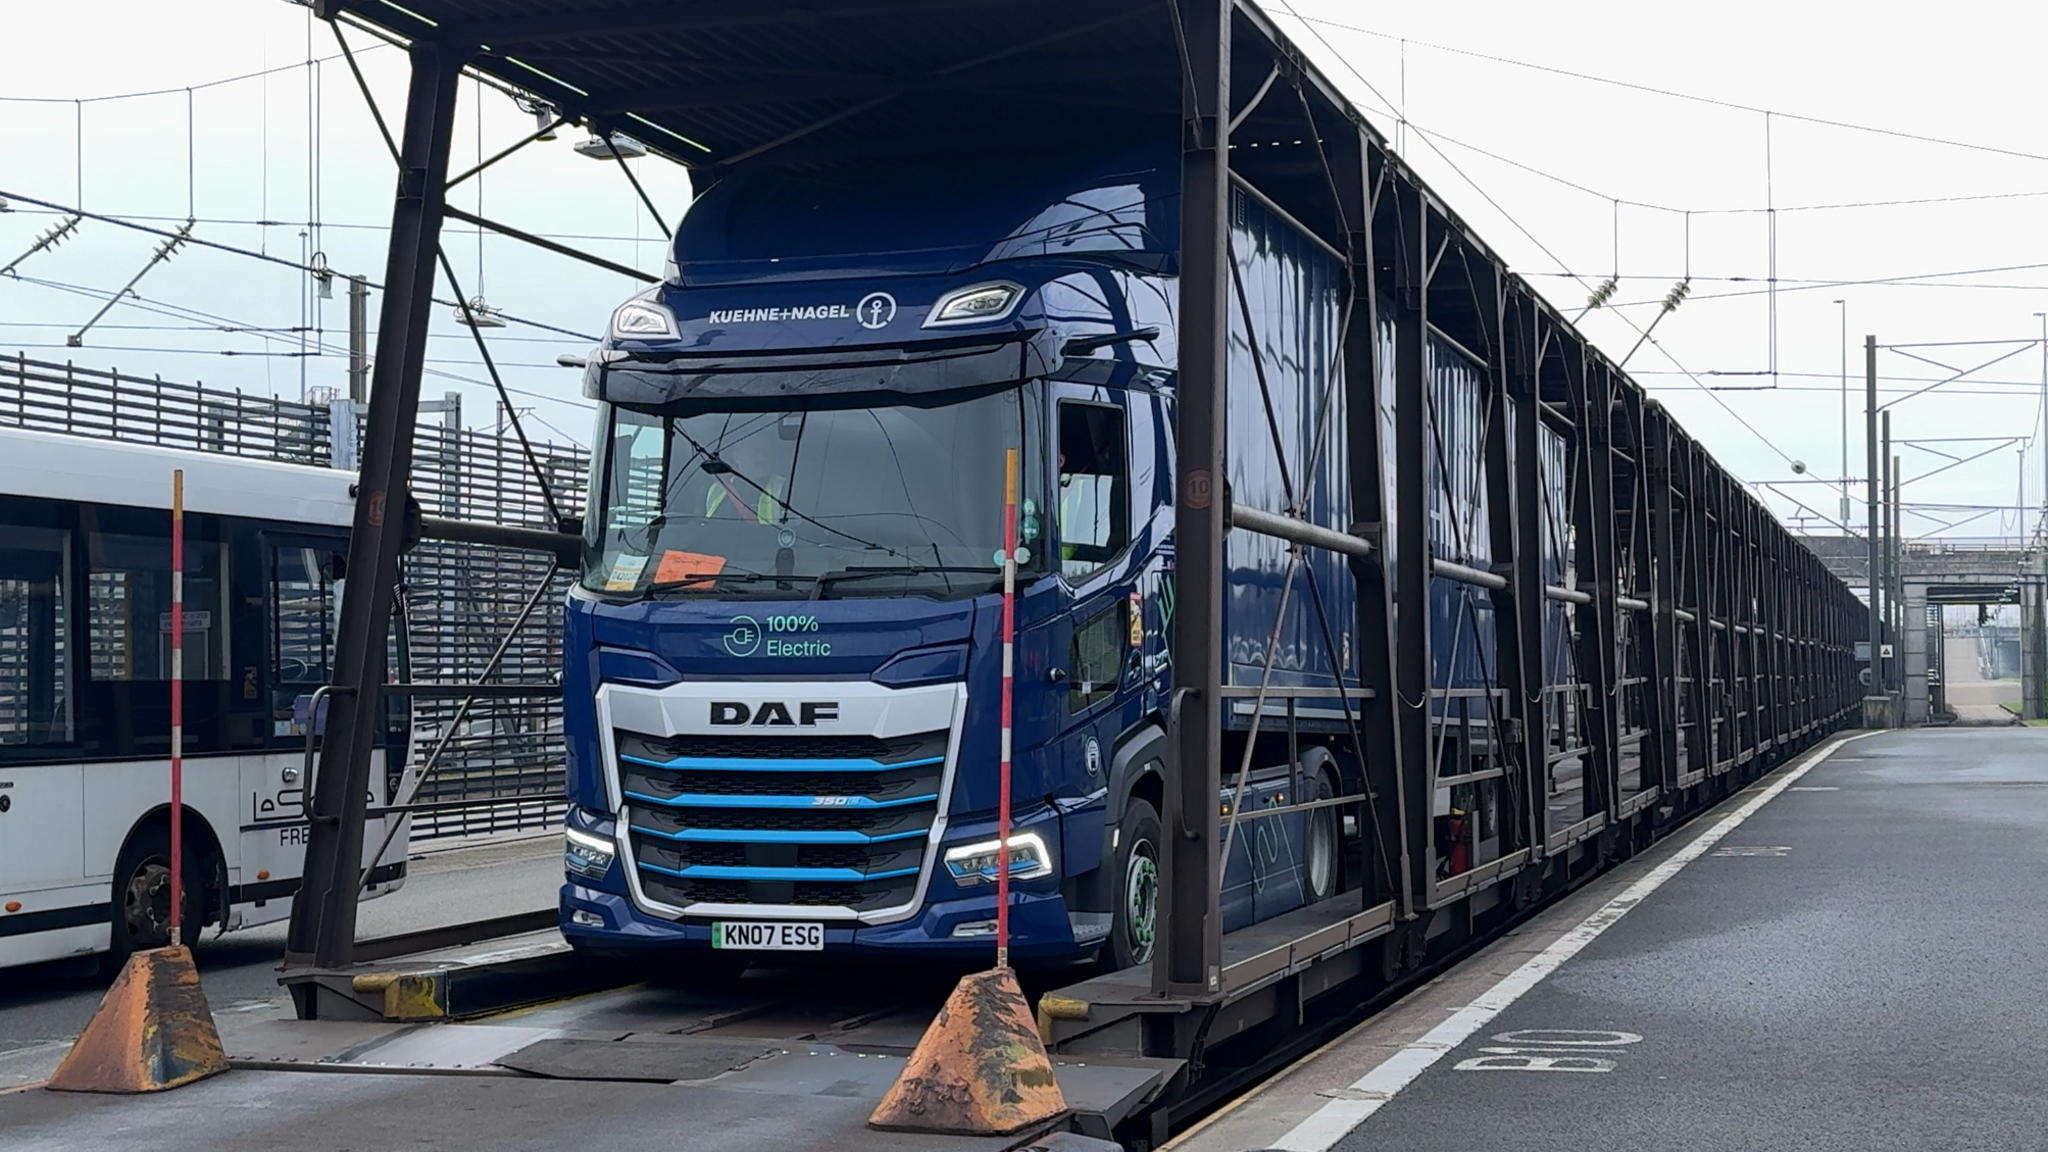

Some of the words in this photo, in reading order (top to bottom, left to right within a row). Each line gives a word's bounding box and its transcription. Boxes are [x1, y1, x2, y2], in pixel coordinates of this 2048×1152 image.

[709, 305, 850, 324] KUEHNE+NAGEL
[1190, 479, 1209, 495] 10
[766, 615, 819, 632] 100%
[767, 640, 831, 656] Electric
[709, 701, 839, 727] DAF
[280, 827, 310, 847] FRE
[725, 924, 776, 946] KN07
[782, 925, 820, 946] ESG
